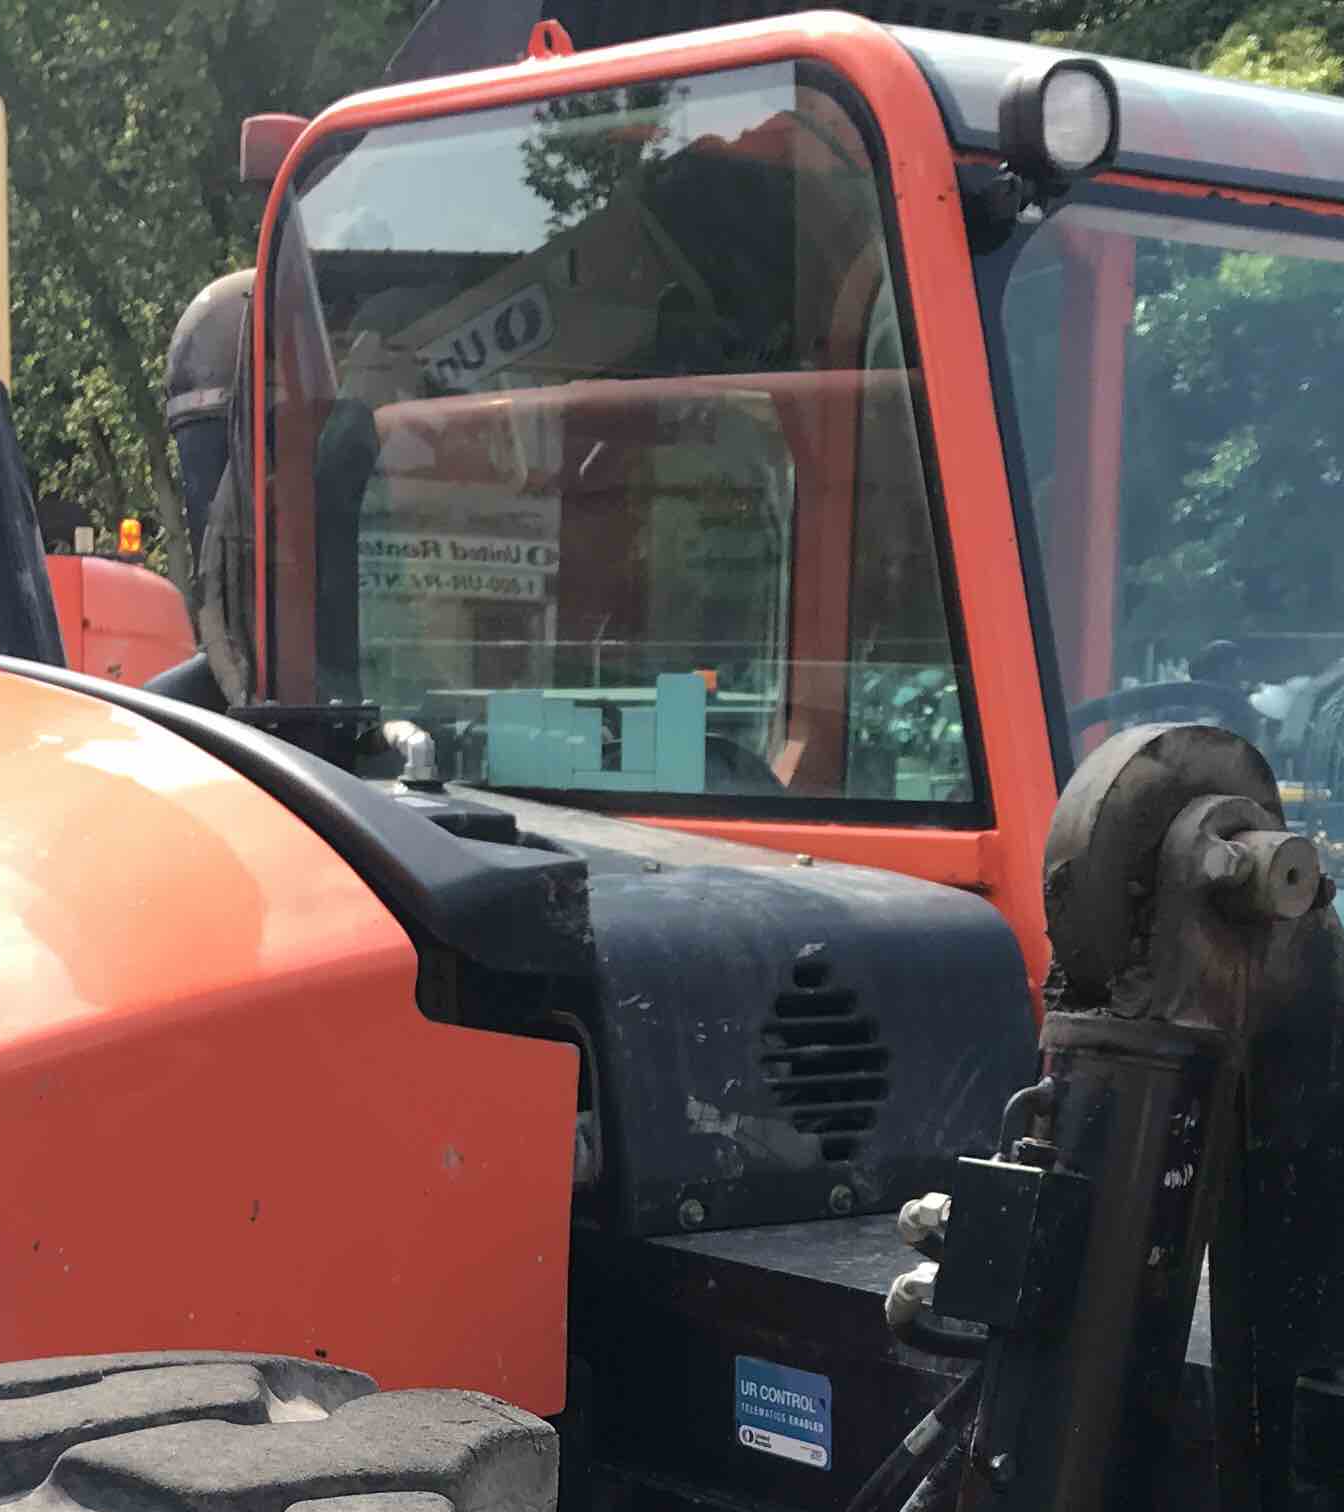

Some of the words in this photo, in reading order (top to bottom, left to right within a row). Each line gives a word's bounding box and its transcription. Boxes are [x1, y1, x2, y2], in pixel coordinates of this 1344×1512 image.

[740, 1379, 758, 1400] UR
[759, 1385, 817, 1414] CONTROL
[788, 1415, 825, 1434] ENABLED
